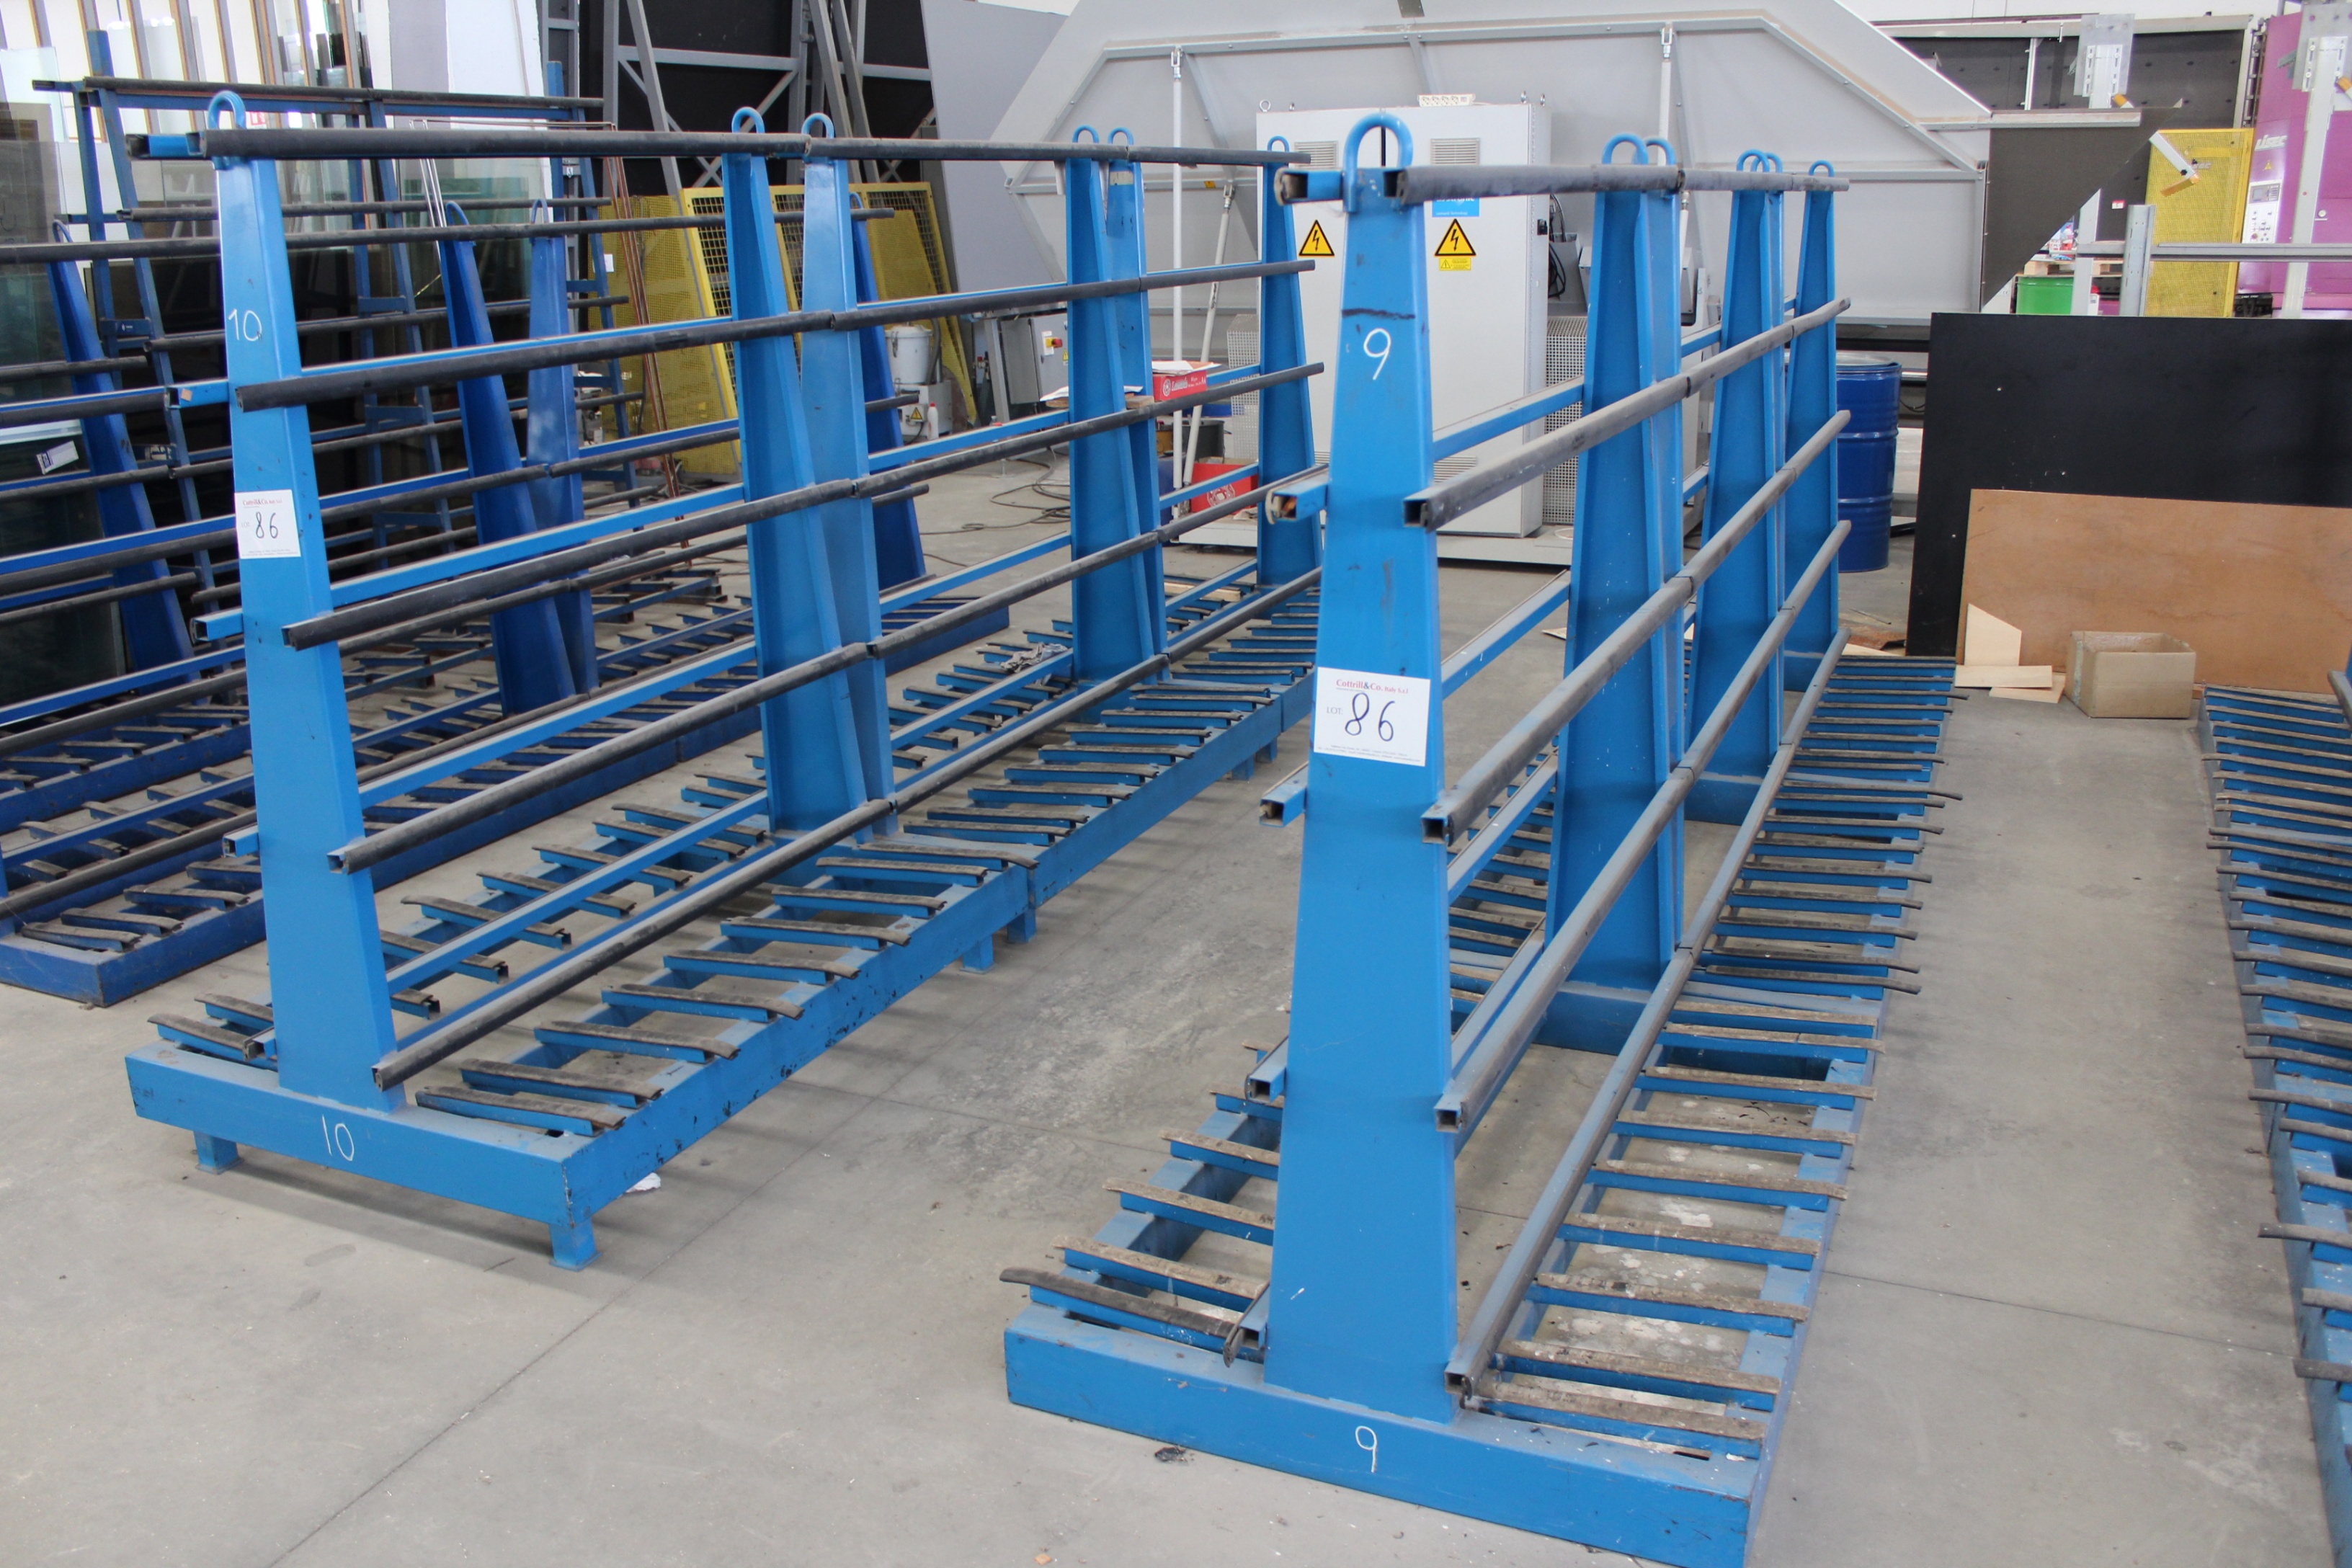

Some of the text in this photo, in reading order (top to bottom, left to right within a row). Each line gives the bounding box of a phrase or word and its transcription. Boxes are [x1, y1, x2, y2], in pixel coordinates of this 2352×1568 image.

[228, 308, 262, 342] 10
[1363, 328, 1391, 380] 9
[256, 511, 278, 539] 86
[1345, 692, 1395, 741] 86
[321, 1114, 355, 1162] 10
[1355, 1425, 1377, 1474] 9
